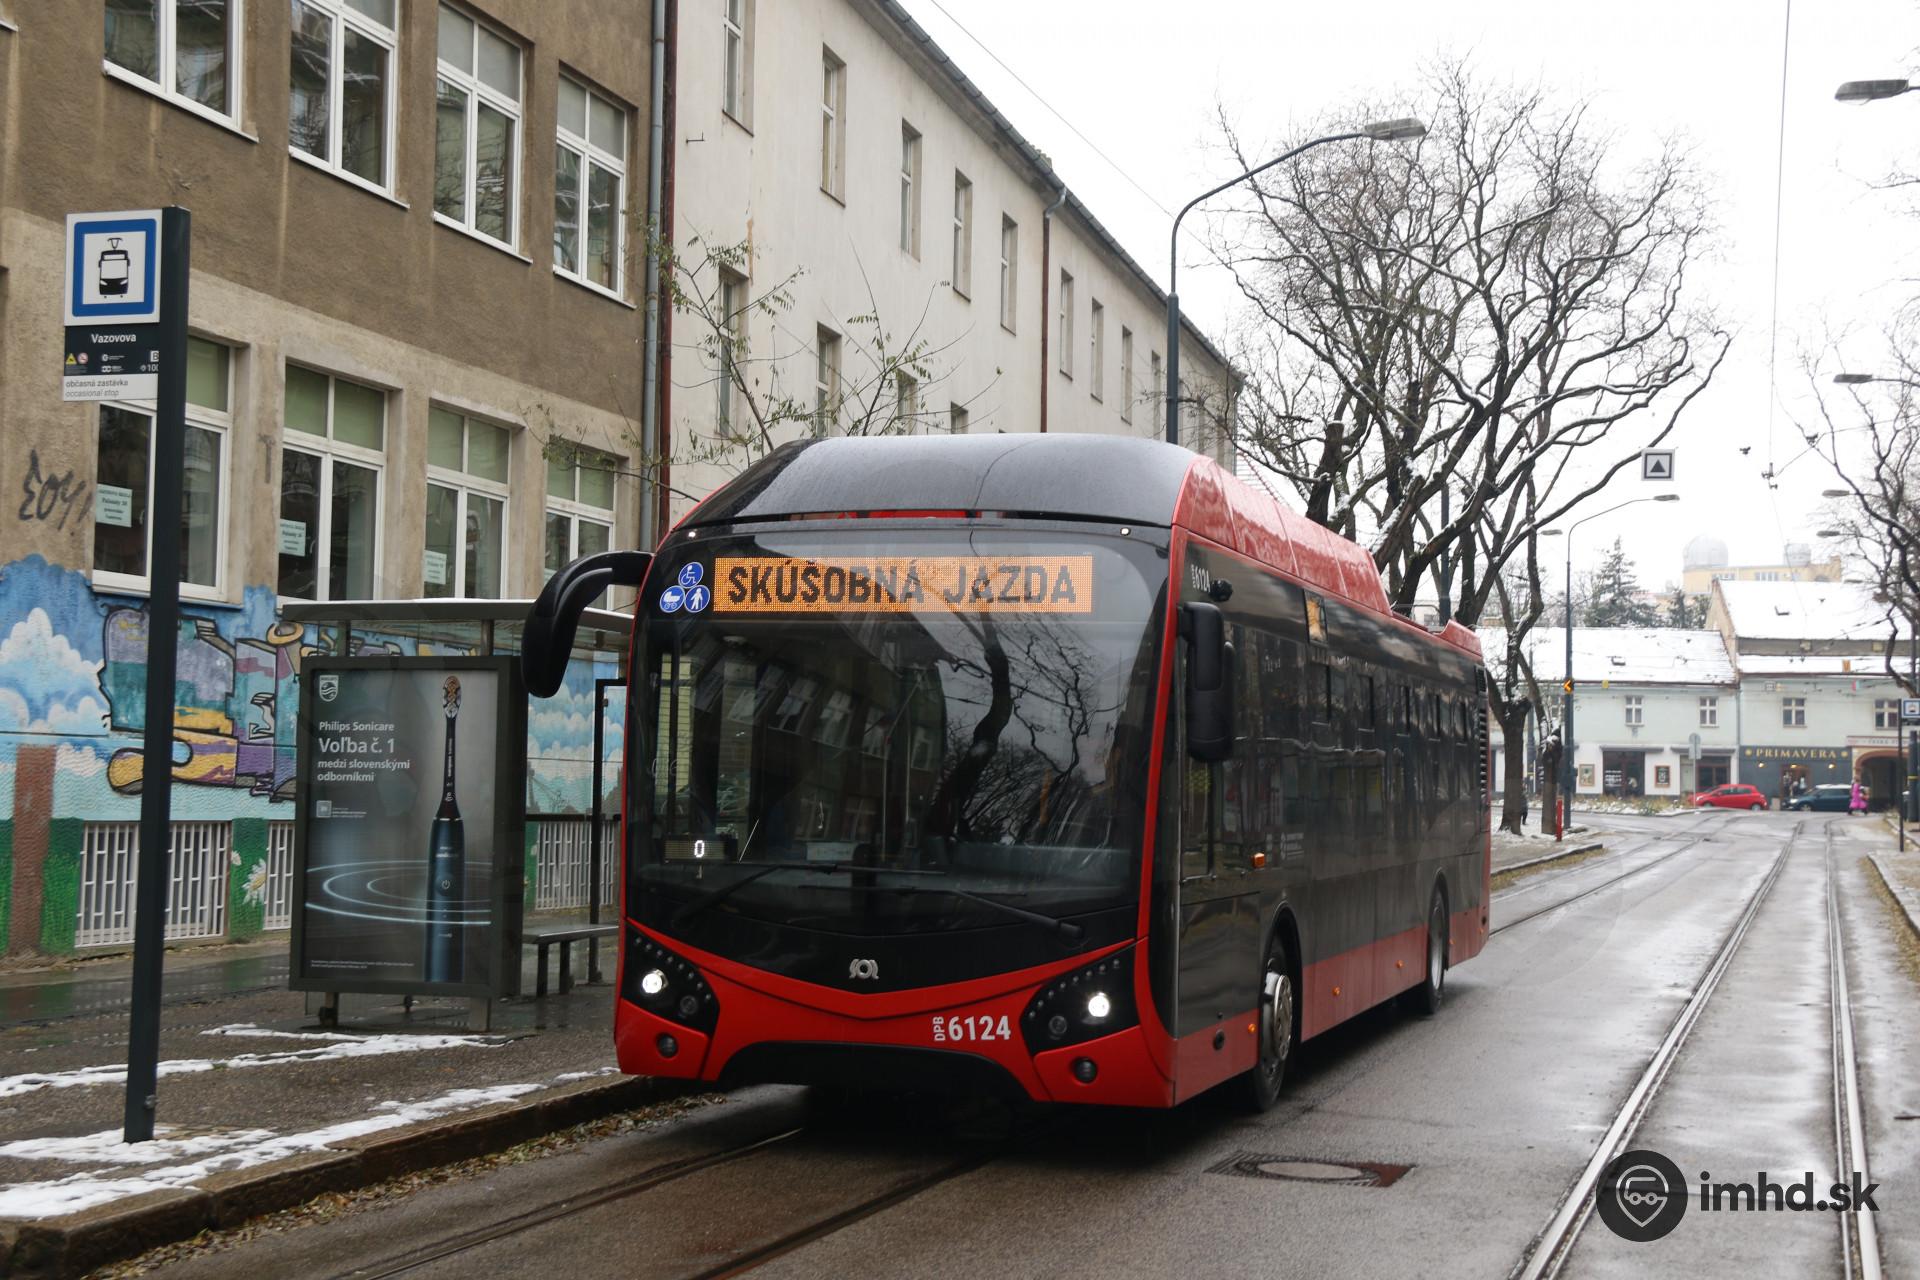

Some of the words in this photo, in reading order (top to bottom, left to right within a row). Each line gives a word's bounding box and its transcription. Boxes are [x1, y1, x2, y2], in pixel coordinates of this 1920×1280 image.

[91, 333, 137, 344] Vazovova
[65, 379, 96, 388] občasná
[97, 379, 129, 388] zastávka
[65, 389, 103, 398] occasional
[104, 389, 120, 398] stop
[728, 558, 924, 604] SKÚŠOBNÁ
[943, 564, 1077, 604] JAZDA
[1194, 565, 1211, 593] 6124
[319, 721, 351, 734] Philips
[352, 721, 395, 732] Sonicare
[318, 736, 368, 754] Voľba
[370, 737, 383, 754] č.
[387, 738, 395, 754] 1
[1755, 749, 1837, 759] PRIMAVERA
[317, 759, 347, 769] medzi
[348, 759, 411, 772] slovenskými
[317, 771, 375, 782] odborníkmi
[932, 1016, 946, 1041] DPB
[948, 1015, 1012, 1041] 6124
